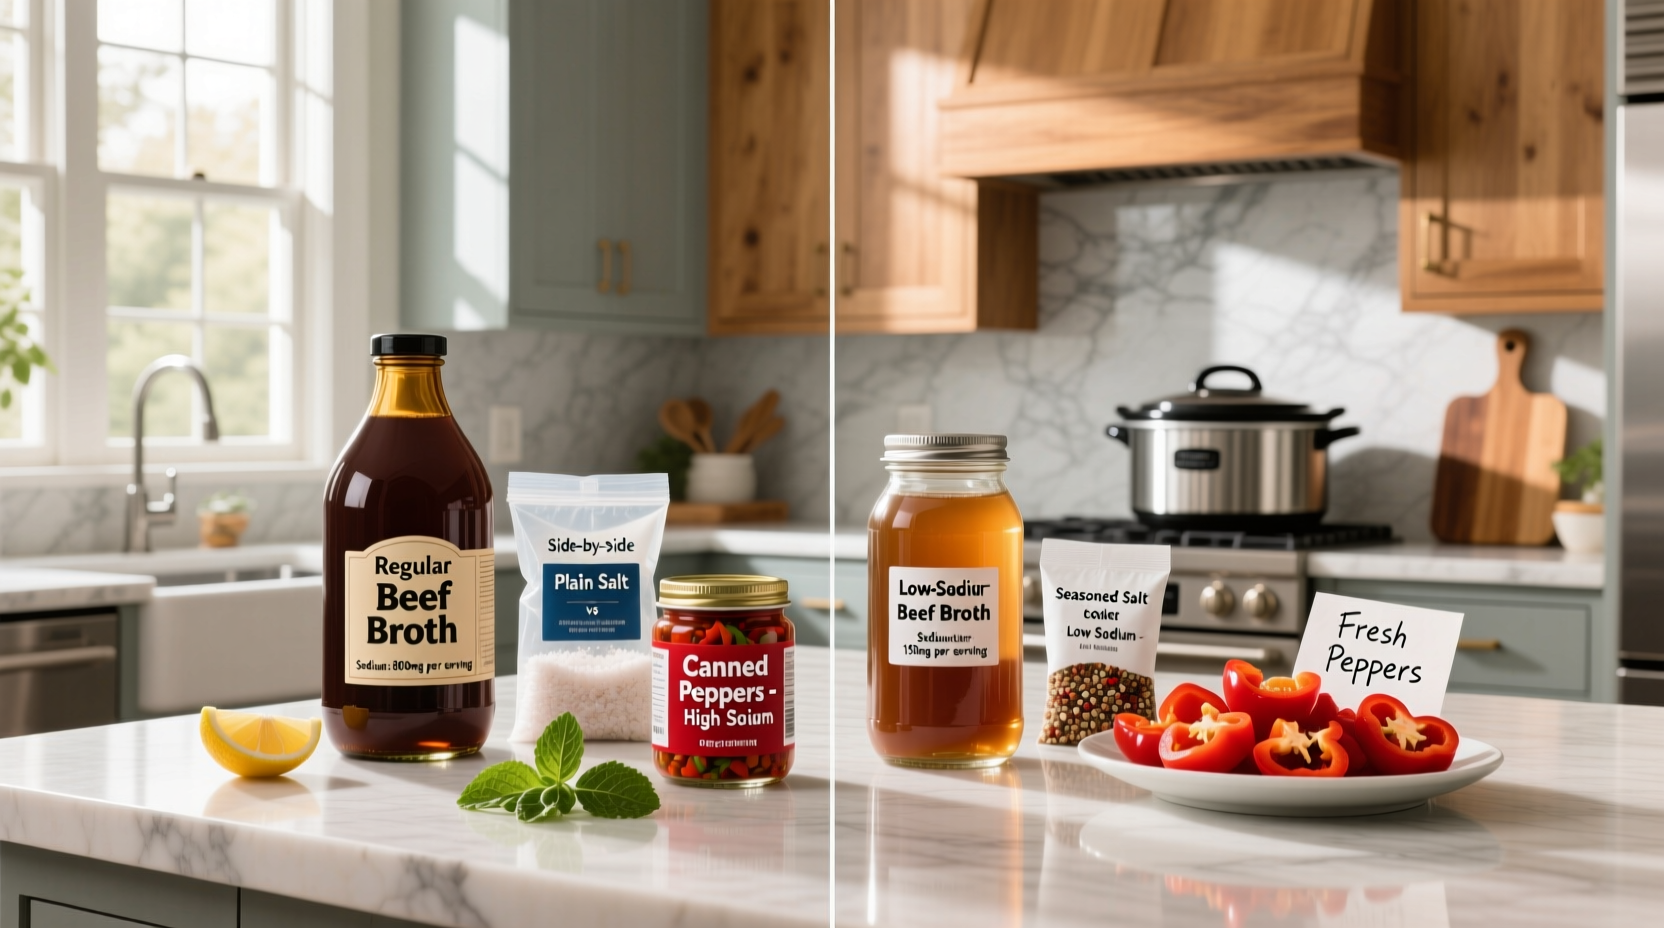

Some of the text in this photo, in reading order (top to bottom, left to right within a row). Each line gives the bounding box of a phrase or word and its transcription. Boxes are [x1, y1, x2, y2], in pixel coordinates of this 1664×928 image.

[375, 555, 452, 581] Regular
[554, 572, 629, 591] Plain Salt
[376, 580, 453, 612] Beef
[1055, 586, 1149, 605] Seasoned Salt
[897, 603, 991, 621] Beef Broth
[367, 614, 457, 645] Broth
[1067, 625, 1091, 639] Low
[1338, 611, 1407, 649] Fresh
[682, 653, 769, 678] Canned
[934, 648, 950, 659] per
[1325, 644, 1422, 687] Peppers
[426, 661, 441, 674] per
[679, 680, 765, 709] Peppers
[684, 708, 720, 731] High
